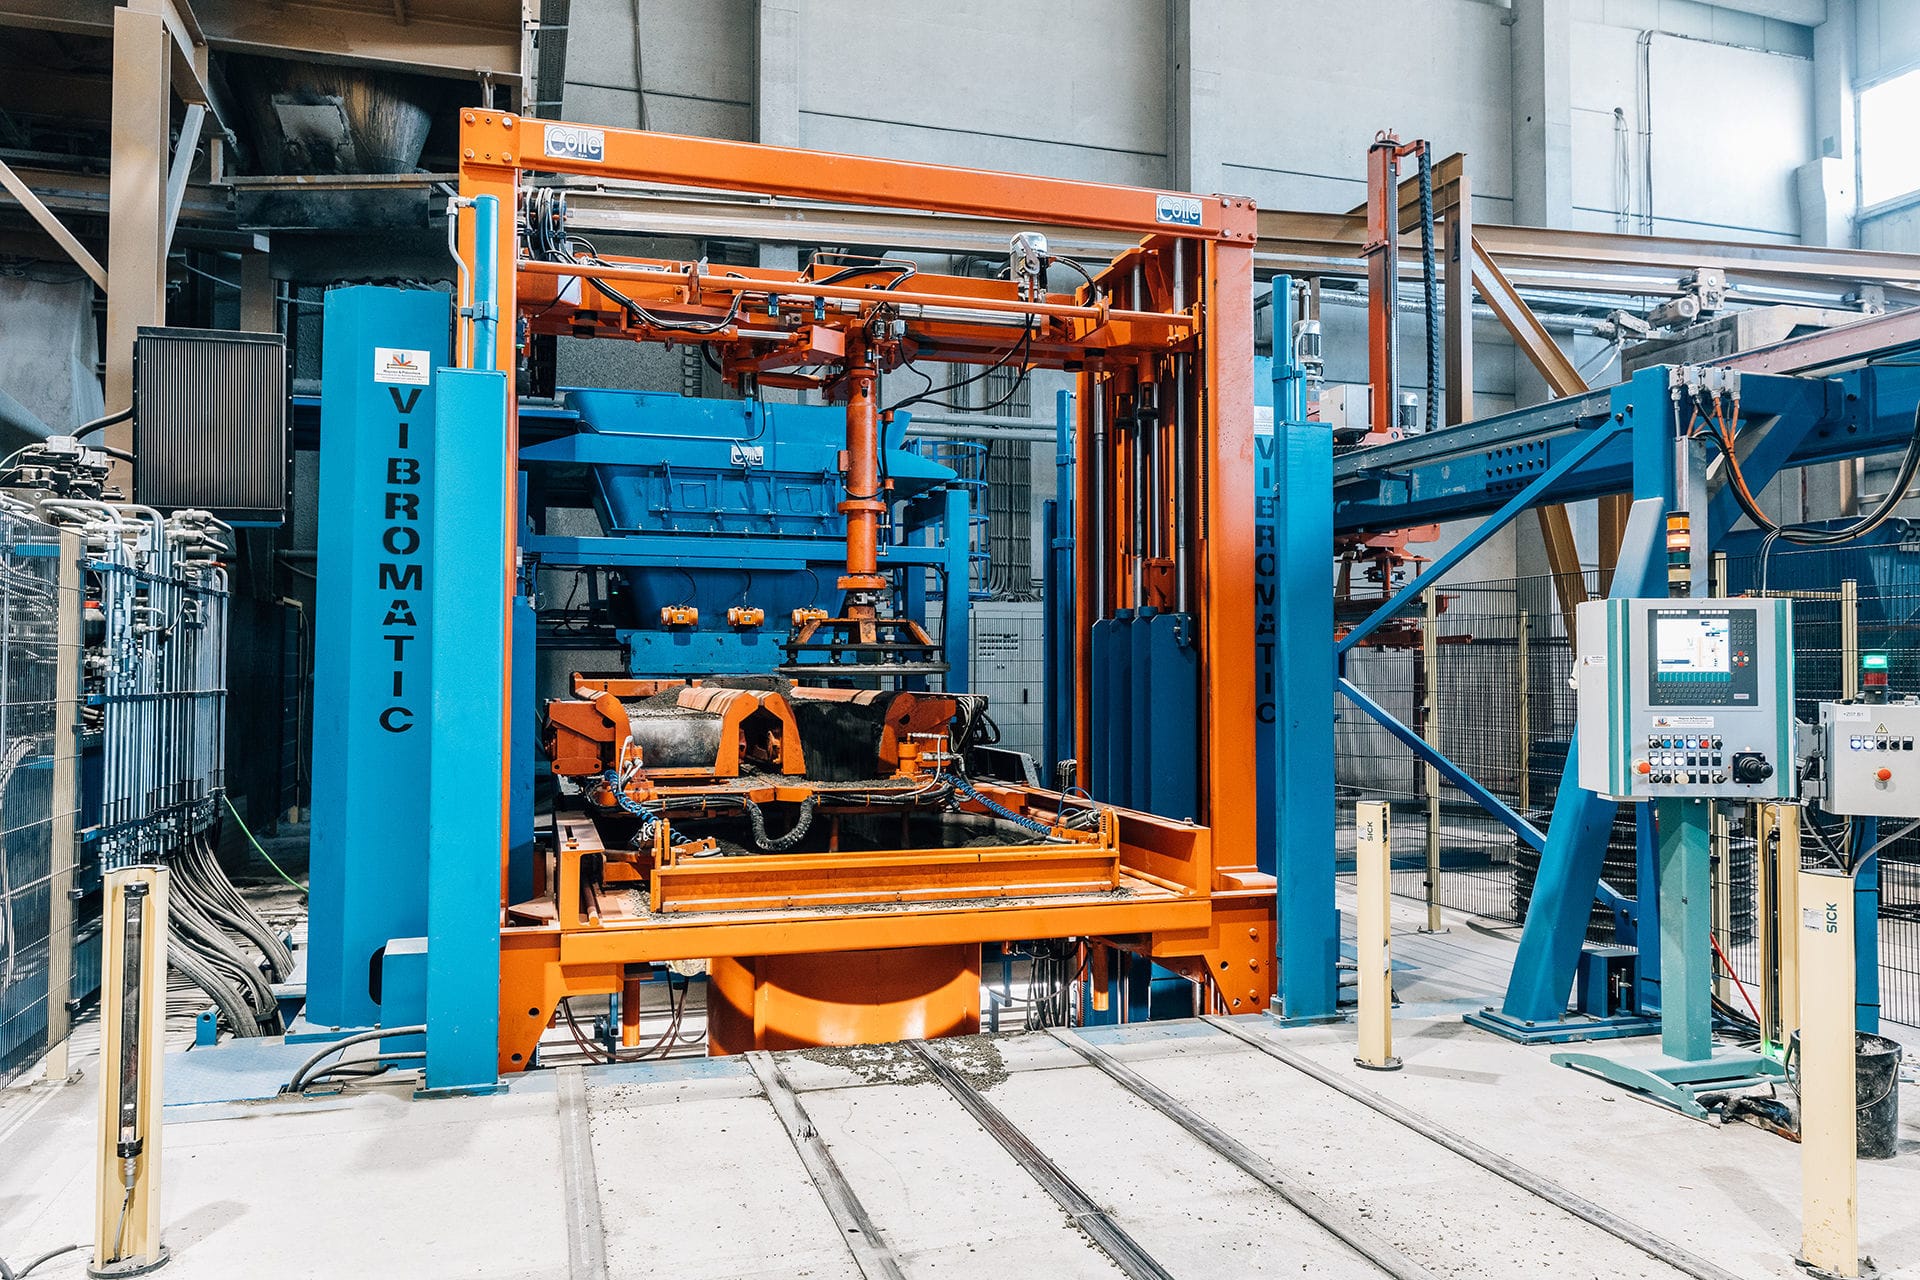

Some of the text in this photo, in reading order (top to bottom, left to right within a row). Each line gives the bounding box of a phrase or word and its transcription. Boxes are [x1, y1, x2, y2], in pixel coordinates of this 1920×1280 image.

[547, 128, 601, 154] Colle
[1159, 198, 1200, 221] Colle
[378, 386, 423, 733] VIBROMATIC
[1366, 821, 1374, 842] SICK
[1826, 902, 1838, 933] SICK
